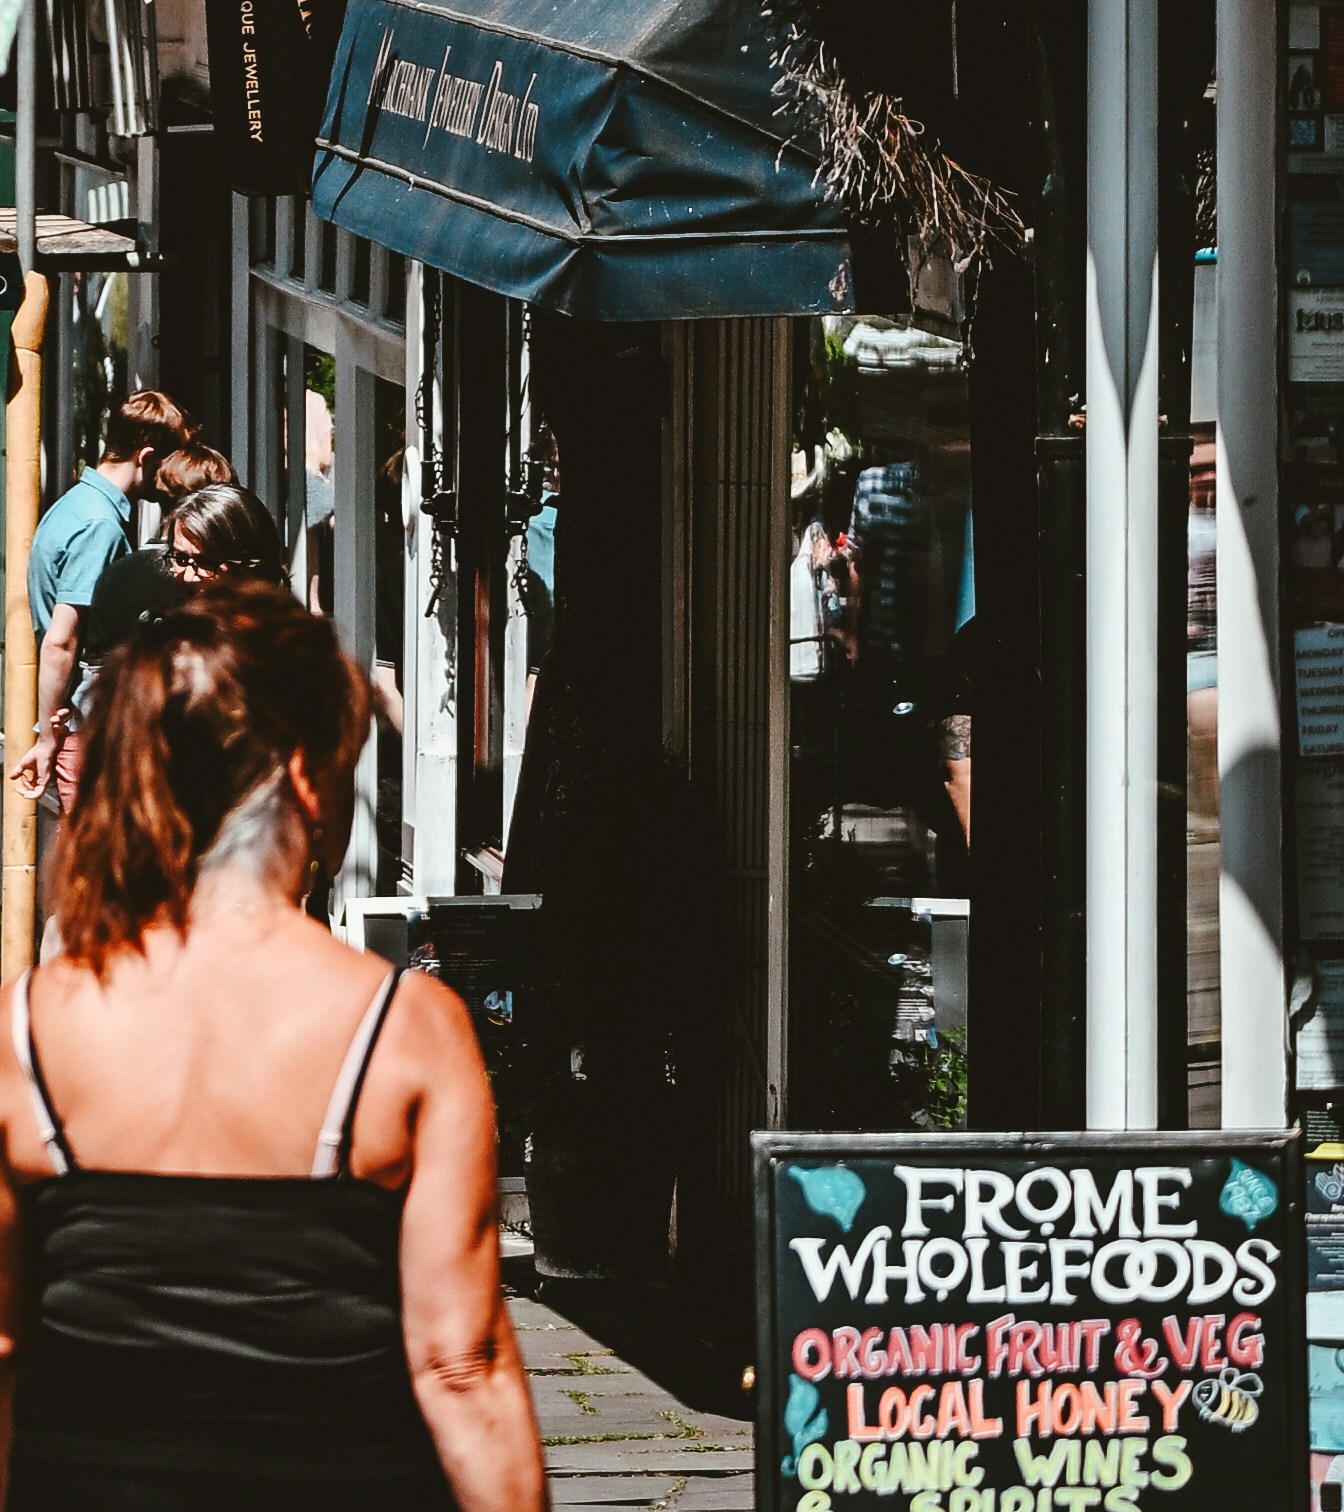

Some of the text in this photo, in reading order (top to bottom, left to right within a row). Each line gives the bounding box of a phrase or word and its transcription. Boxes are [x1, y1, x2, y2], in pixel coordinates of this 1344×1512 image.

[242, 41, 264, 144] JEWELLERY
[894, 1166, 1198, 1239] FROME
[789, 1225, 1281, 1306] WHOLEFOODS
[792, 1312, 1264, 1381] ORGANIC FRUIT & VEG
[846, 1378, 1194, 1441] LOCAL HONEY
[797, 1436, 1193, 1494] ORGANIC WINES
